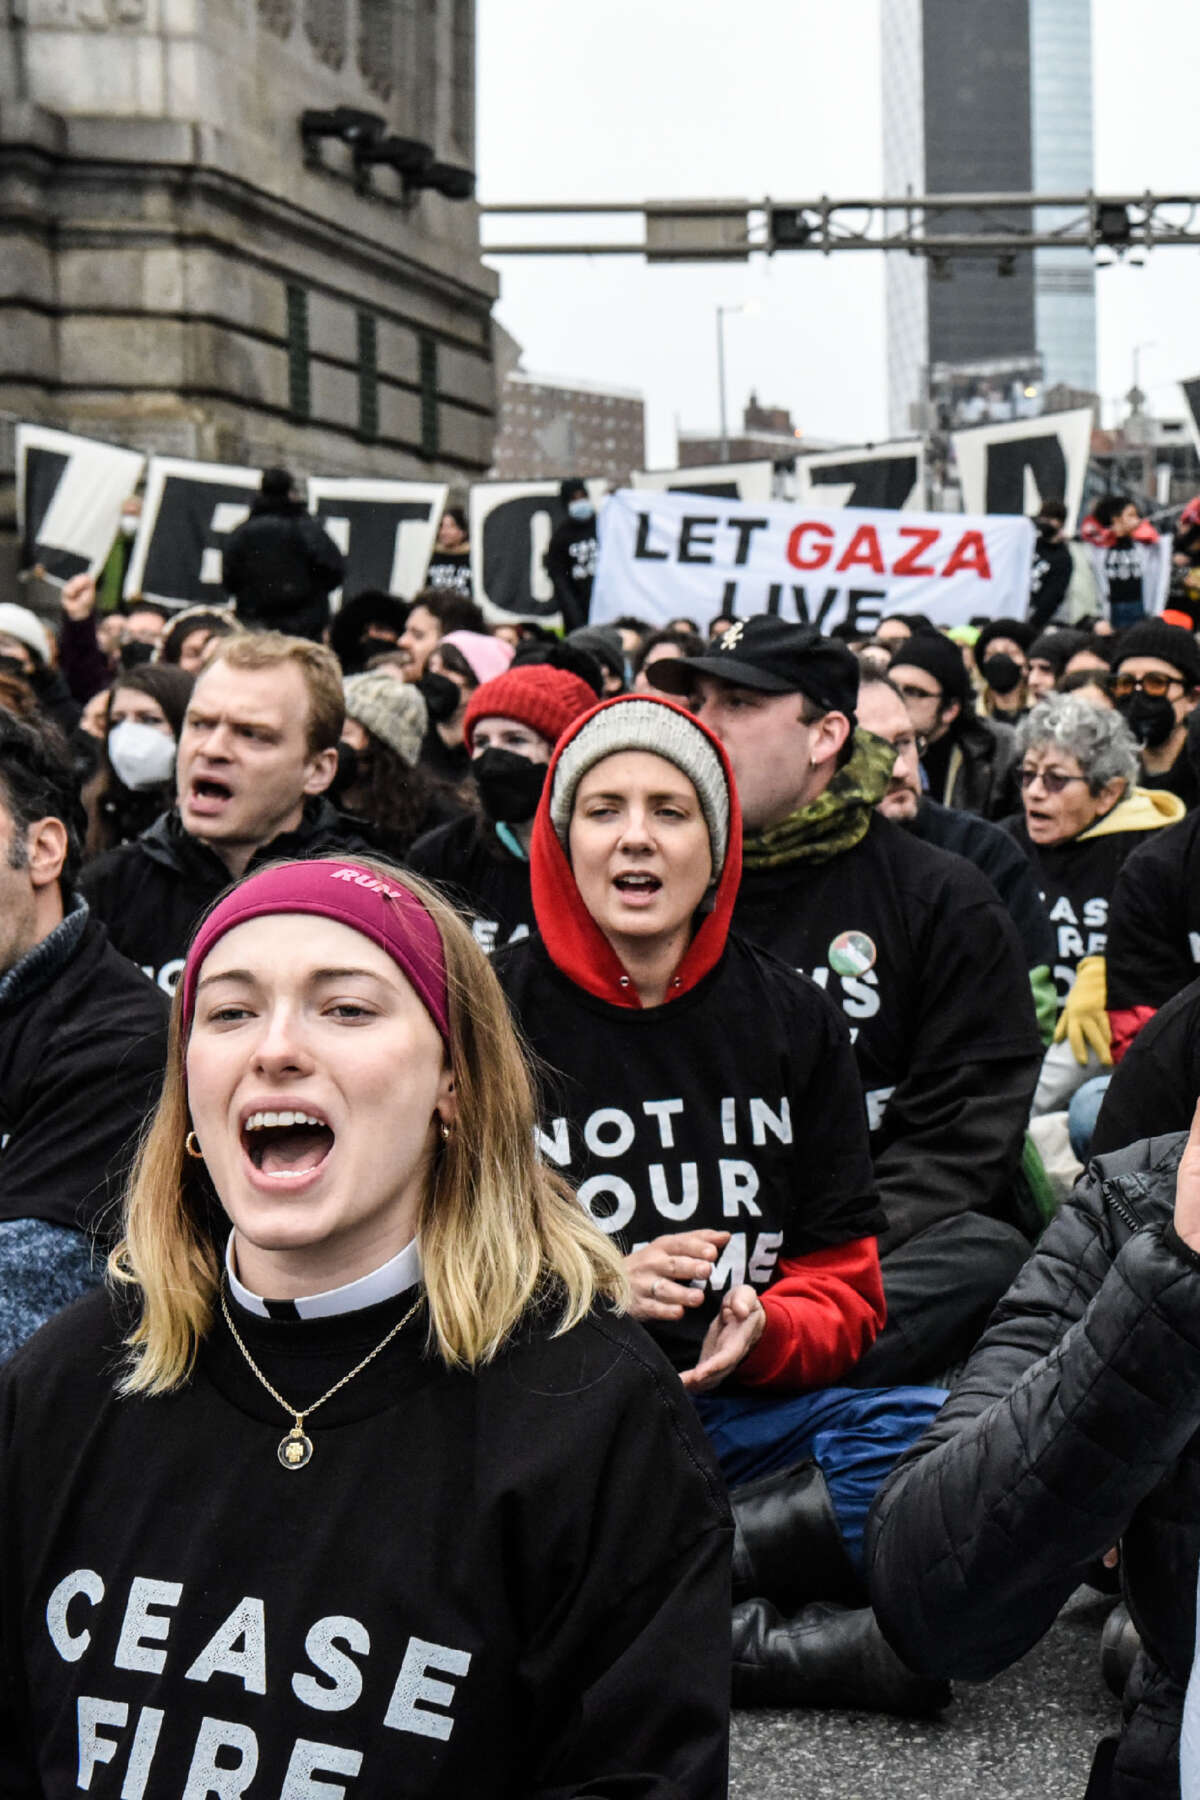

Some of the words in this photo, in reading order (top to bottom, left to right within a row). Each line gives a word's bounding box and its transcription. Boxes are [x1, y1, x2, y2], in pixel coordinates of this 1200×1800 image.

[634, 512, 768, 566] LET
[785, 521, 992, 580] GAZA
[722, 581, 887, 636] LIVE
[330, 868, 402, 899] RUN
[533, 1098, 684, 1167] NOT
[721, 1096, 793, 1146] IN
[576, 1158, 763, 1235] OUR
[46, 1568, 472, 1741] CEASE
[77, 1696, 364, 1800] FIRE
